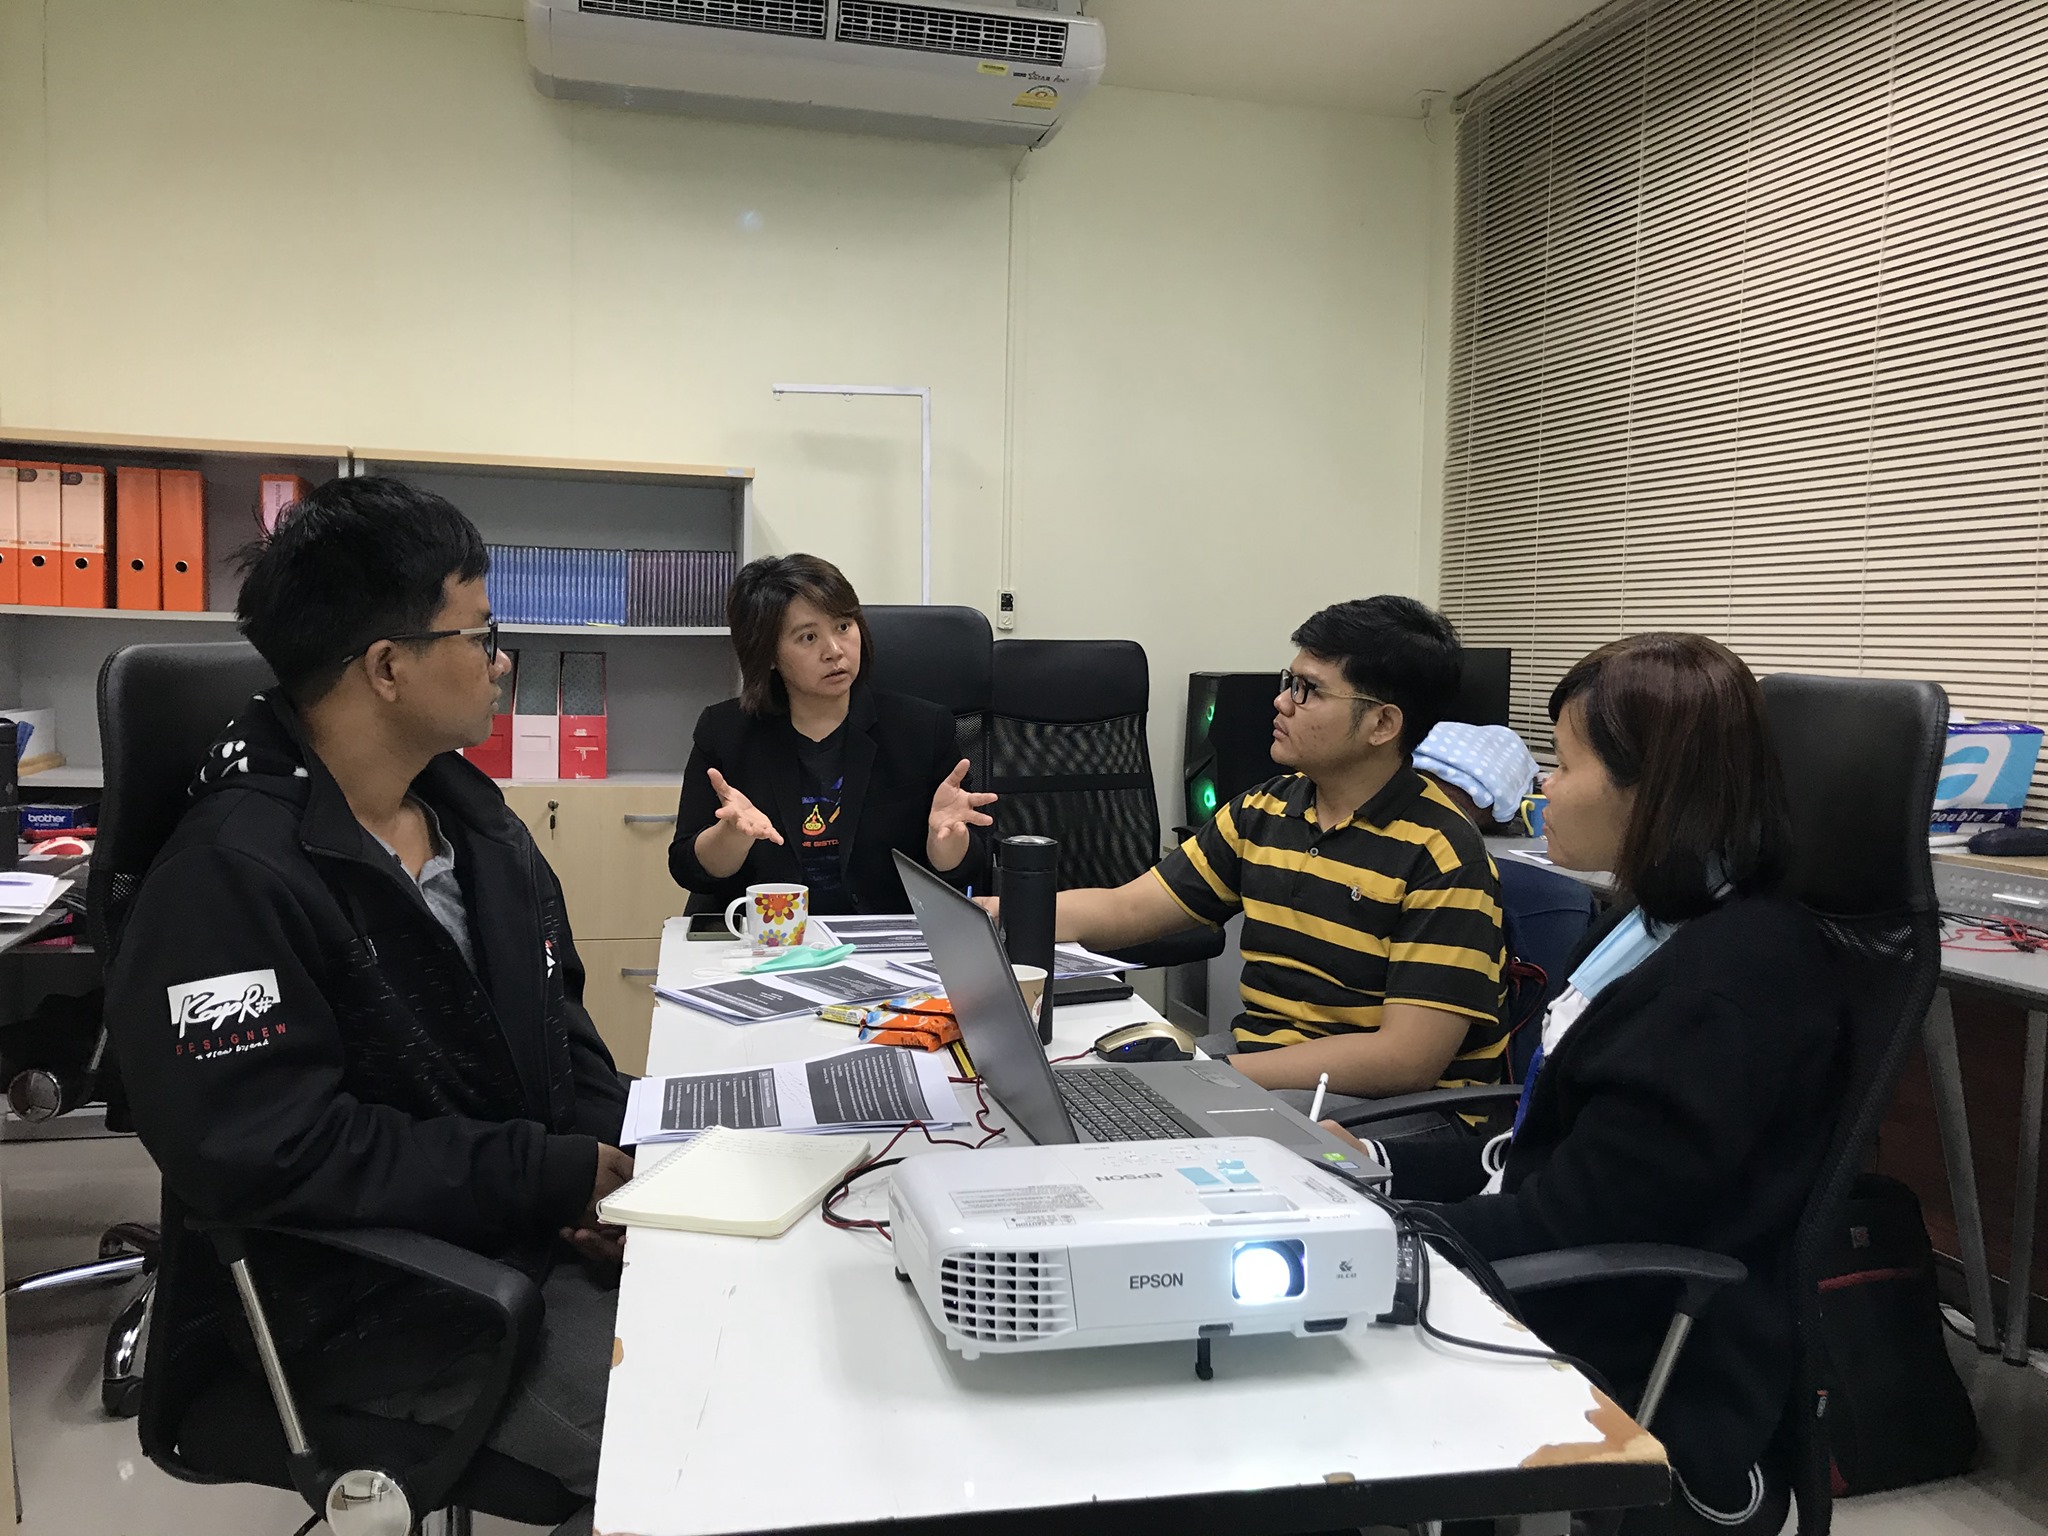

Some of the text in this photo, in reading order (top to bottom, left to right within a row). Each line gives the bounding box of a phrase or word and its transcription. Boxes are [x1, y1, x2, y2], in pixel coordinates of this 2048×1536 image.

[28, 814, 66, 823] brother
[1931, 811, 2003, 822] Double A
[175, 1023, 287, 1055] DESIGNEW
[1095, 1172, 1163, 1182] EPSON
[1129, 1272, 1184, 1290] EPSON
